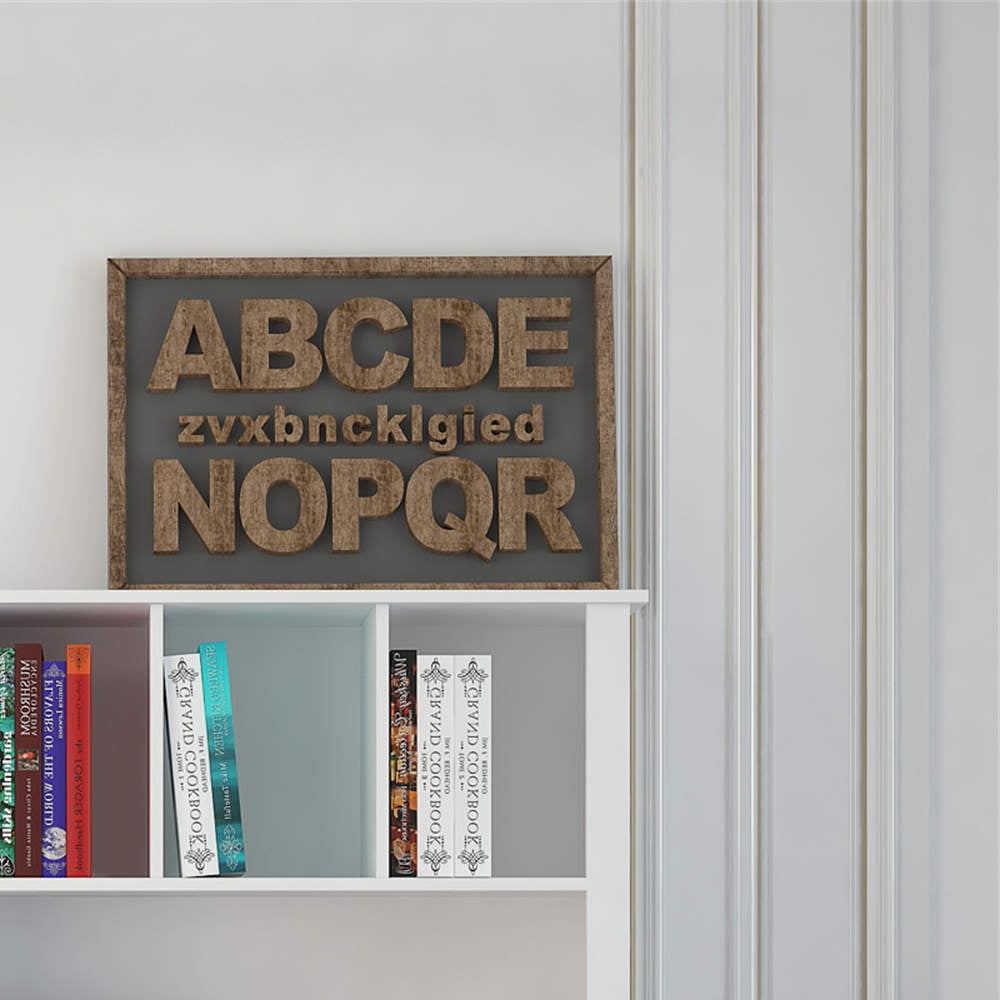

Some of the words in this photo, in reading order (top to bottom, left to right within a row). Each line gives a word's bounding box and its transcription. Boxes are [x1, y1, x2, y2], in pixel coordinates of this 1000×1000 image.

[147, 296, 575, 393] ABCDE
[177, 404, 544, 455] zvxbncklgied
[152, 457, 583, 563] NOPQR
